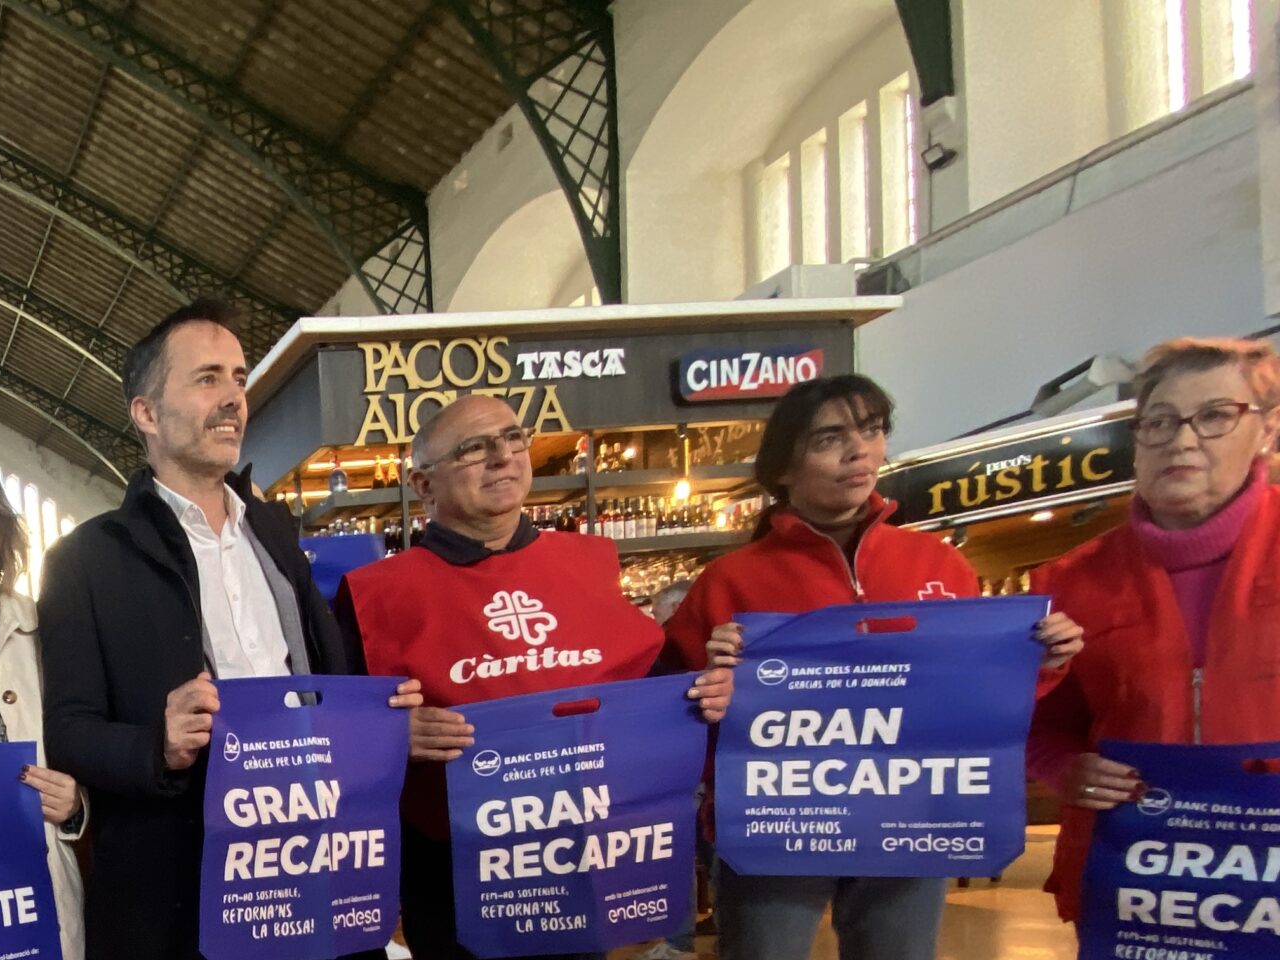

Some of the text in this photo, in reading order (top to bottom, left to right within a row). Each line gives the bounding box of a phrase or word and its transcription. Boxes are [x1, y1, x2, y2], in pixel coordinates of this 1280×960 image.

[358, 335, 511, 392] PACO'S
[516, 348, 626, 380] TASCA
[686, 351, 817, 392] CINZANO
[927, 435, 1114, 514] rústic
[986, 454, 1032, 476] paco's
[449, 646, 603, 684] Càritas
[792, 664, 911, 676] BANC DELS ALIMENTS
[846, 679, 857, 688] LA
[749, 707, 903, 747] GRAN
[243, 742, 267, 751] BANC
[269, 740, 290, 749] DELS
[504, 743, 605, 765] BANC DELS ALIMENTS
[276, 757, 289, 767] PER
[292, 755, 302, 765] LA
[540, 766, 555, 777] PER
[559, 764, 571, 774] LA
[746, 757, 990, 796] RECAPTE
[223, 779, 340, 828] GRAN
[476, 785, 610, 836] GRAN
[1174, 801, 1208, 812] BANC
[1211, 803, 1241, 814] DELS
[746, 818, 841, 837] ¡DEVUÉLVENOS
[479, 822, 674, 882] RECAPTE
[786, 838, 856, 851] LA BOLSA!
[882, 833, 984, 852] endesa
[224, 829, 385, 882] RECAPTE
[223, 904, 292, 924] RETORNA'NS
[332, 907, 381, 930] endesa
[481, 901, 561, 919] RETORNA'NS
[608, 898, 668, 923] endesa
[252, 919, 314, 939] LA BOSSA!
[516, 915, 586, 933] LA BOSSA!
